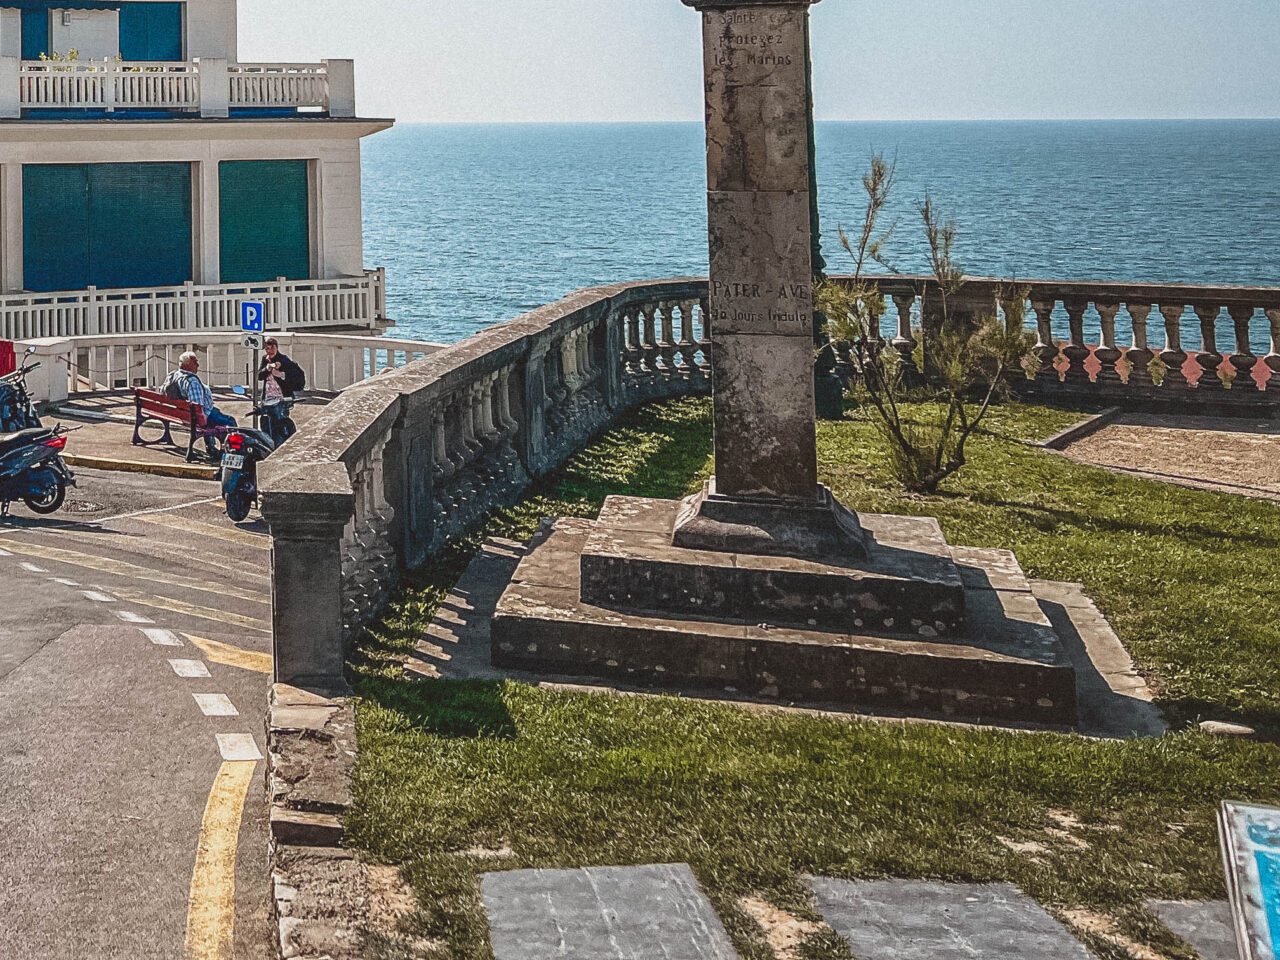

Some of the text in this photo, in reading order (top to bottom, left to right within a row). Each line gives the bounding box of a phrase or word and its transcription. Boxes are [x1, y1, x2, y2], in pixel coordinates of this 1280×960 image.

[714, 53, 793, 66] les Marins
[712, 280, 761, 298] PATER
[779, 283, 809, 300] AVE
